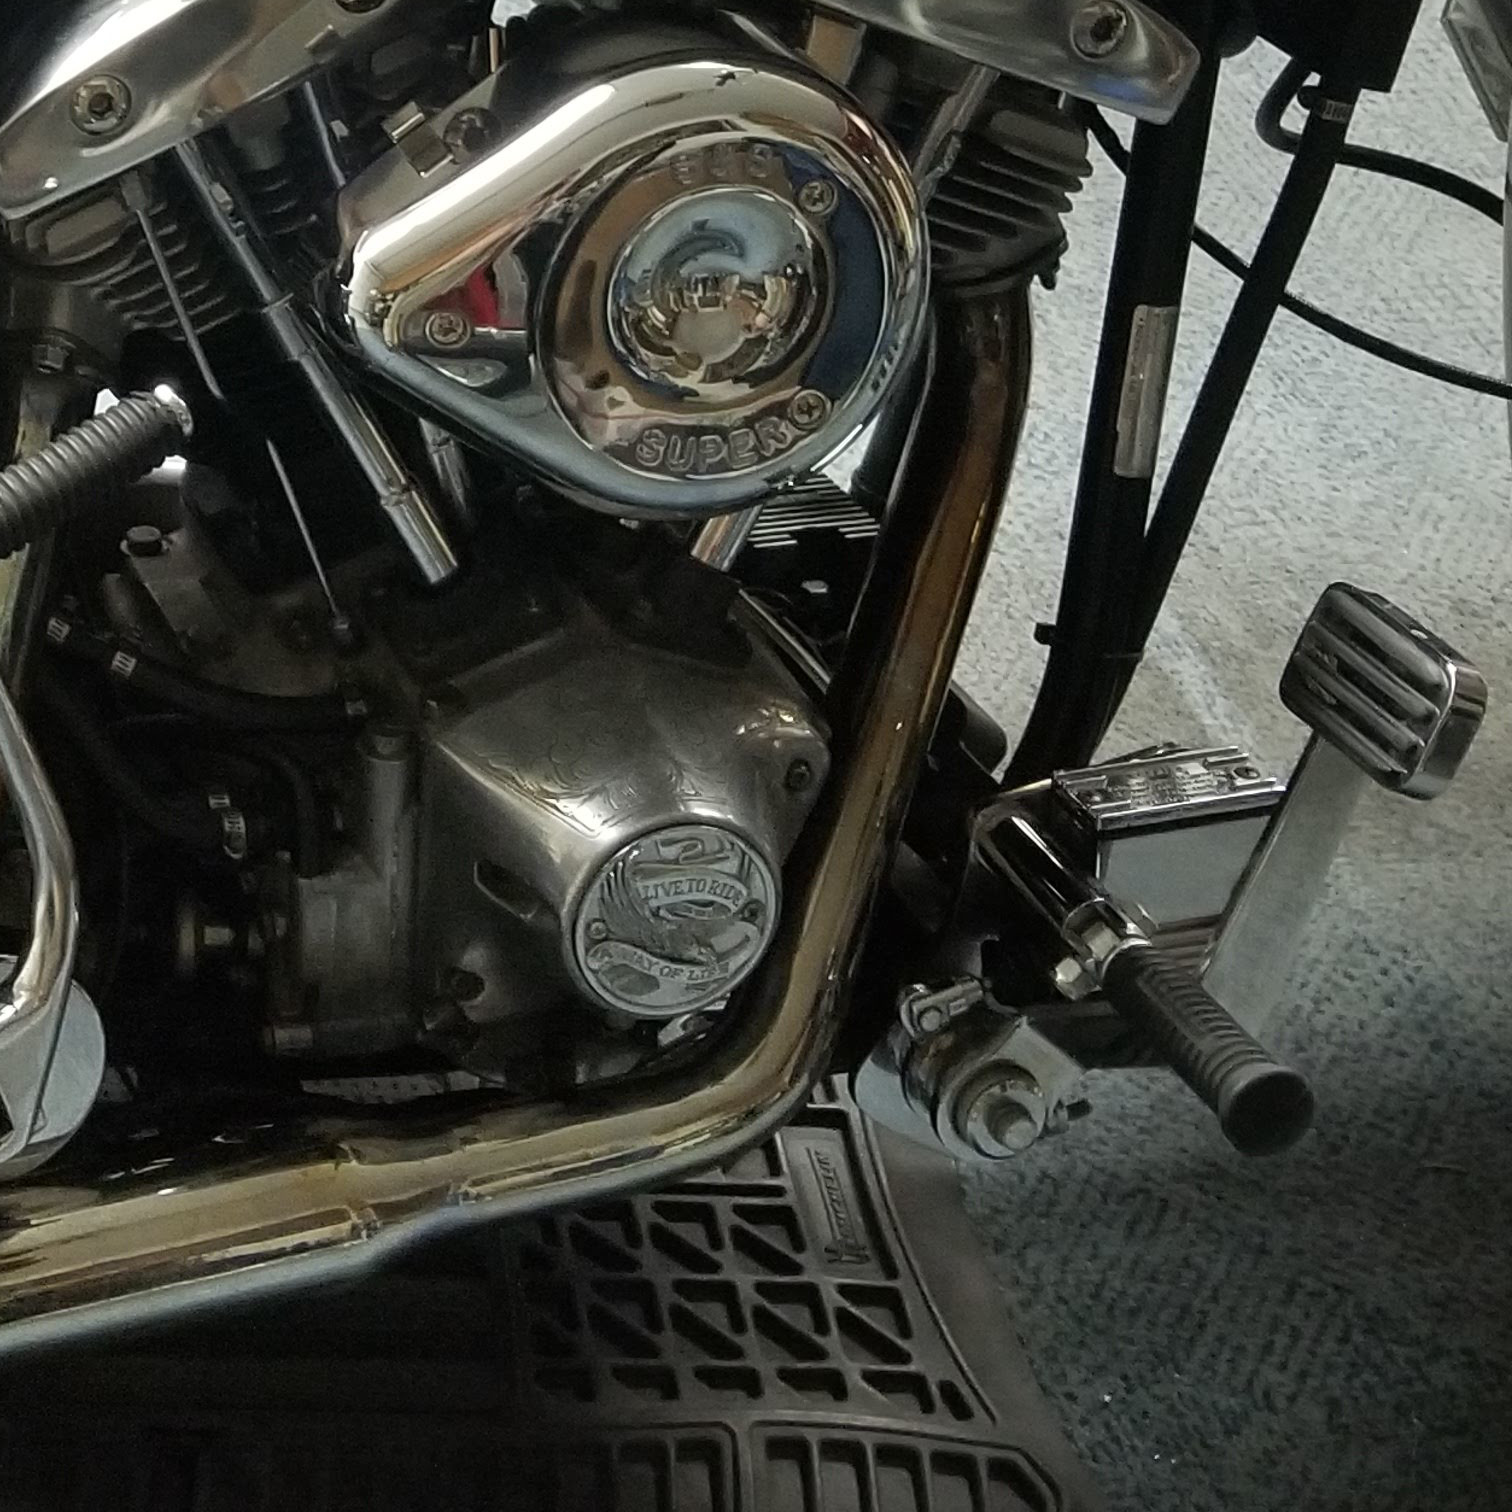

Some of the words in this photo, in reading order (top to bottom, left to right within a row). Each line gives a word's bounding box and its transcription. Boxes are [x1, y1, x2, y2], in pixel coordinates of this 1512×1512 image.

[635, 417, 794, 472] SUPER
[639, 879, 686, 901] LIVE
[684, 877, 707, 894] TO
[706, 880, 745, 907] RIDE
[659, 965, 685, 980] OF
